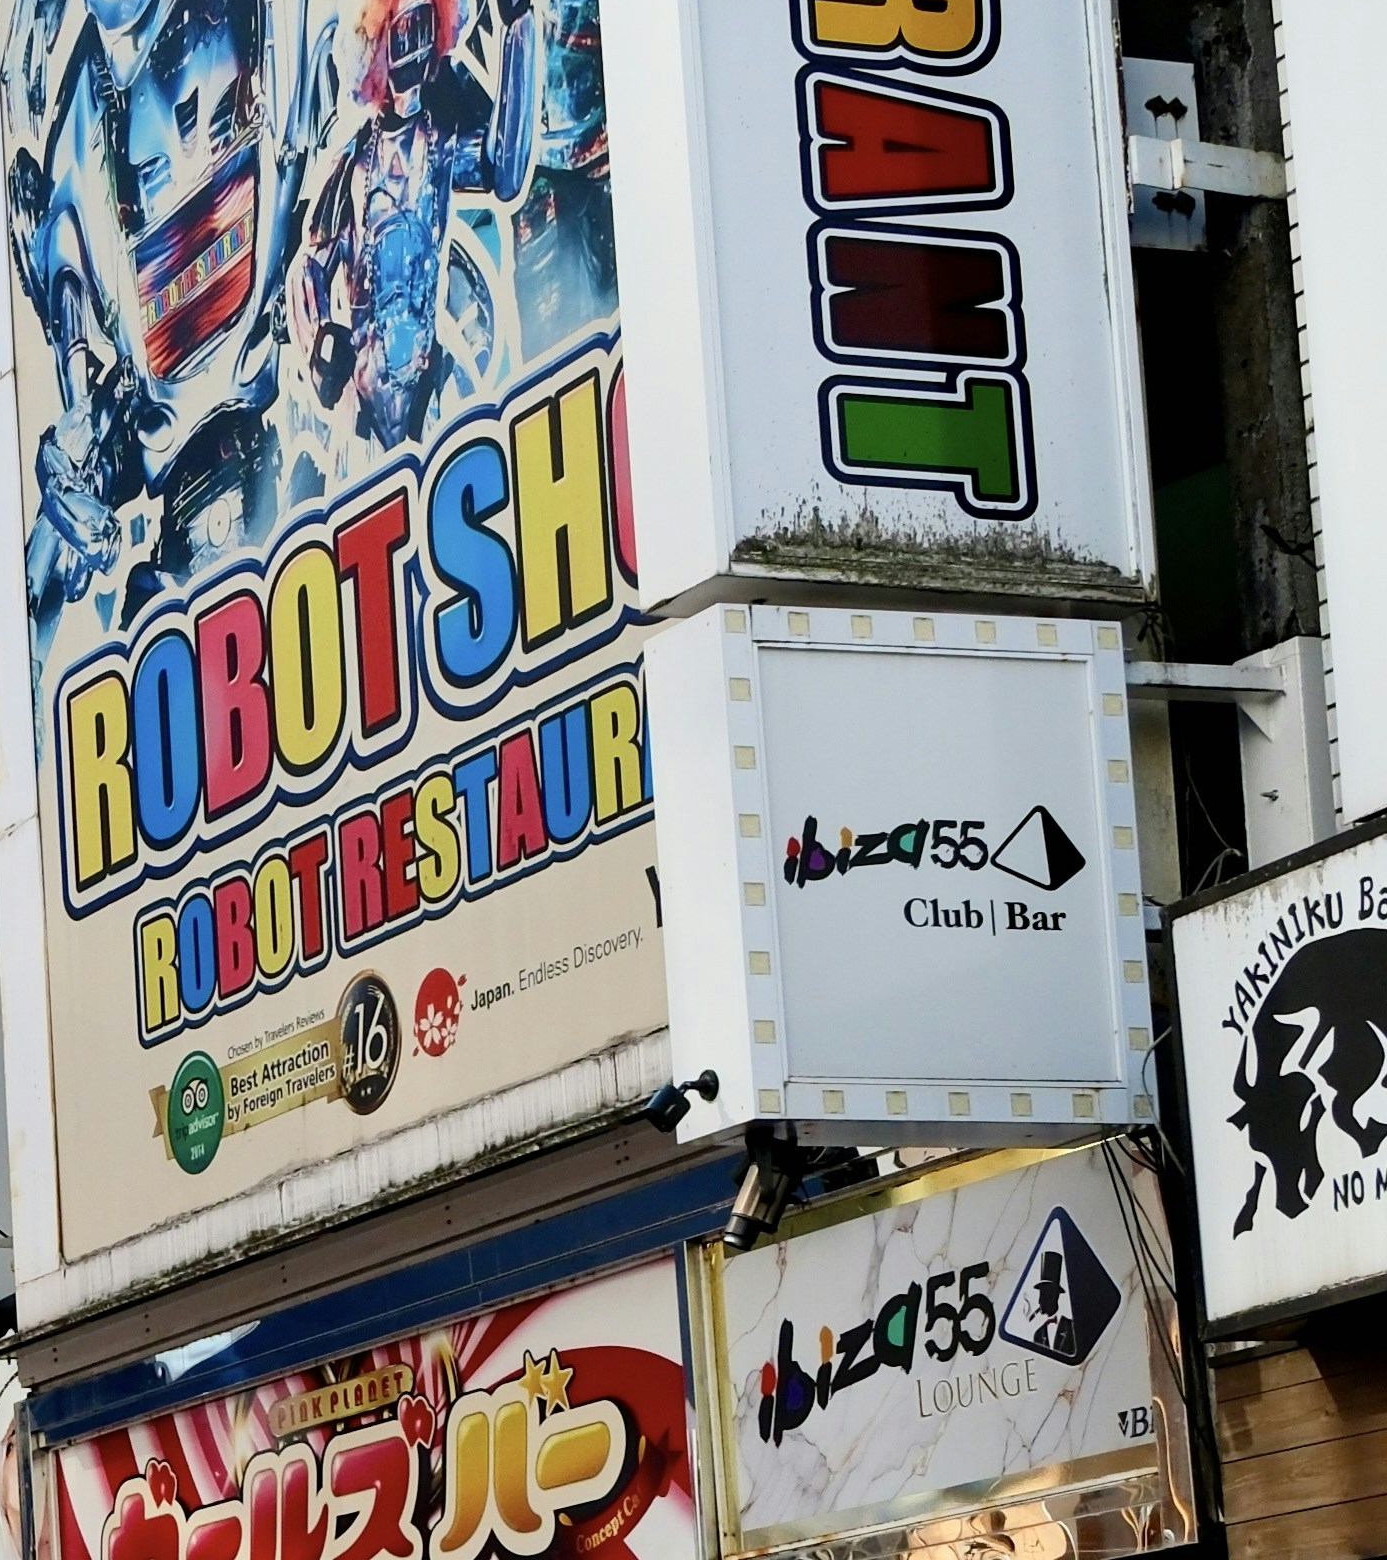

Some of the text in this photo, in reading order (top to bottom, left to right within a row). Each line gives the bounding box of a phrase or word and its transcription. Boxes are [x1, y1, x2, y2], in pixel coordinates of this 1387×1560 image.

[62, 324, 639, 919] ROBOT SH
[140, 672, 655, 1046] ROBOT RESTAUR
[784, 816, 989, 890] ibiza55
[902, 896, 1066, 933] Club Bar
[470, 927, 644, 1012] Japan. Endless Discovery.
[1222, 892, 1345, 1037] YAKINIKU
[227, 1064, 335, 1121] by Foreign Travelers
[229, 1041, 330, 1095] Best Attraction
[1333, 1171, 1365, 1212] NO
[757, 1260, 997, 1449] ibiza55
[915, 1358, 1038, 1418] LOUNGE
[575, 1506, 625, 1555] Concept
